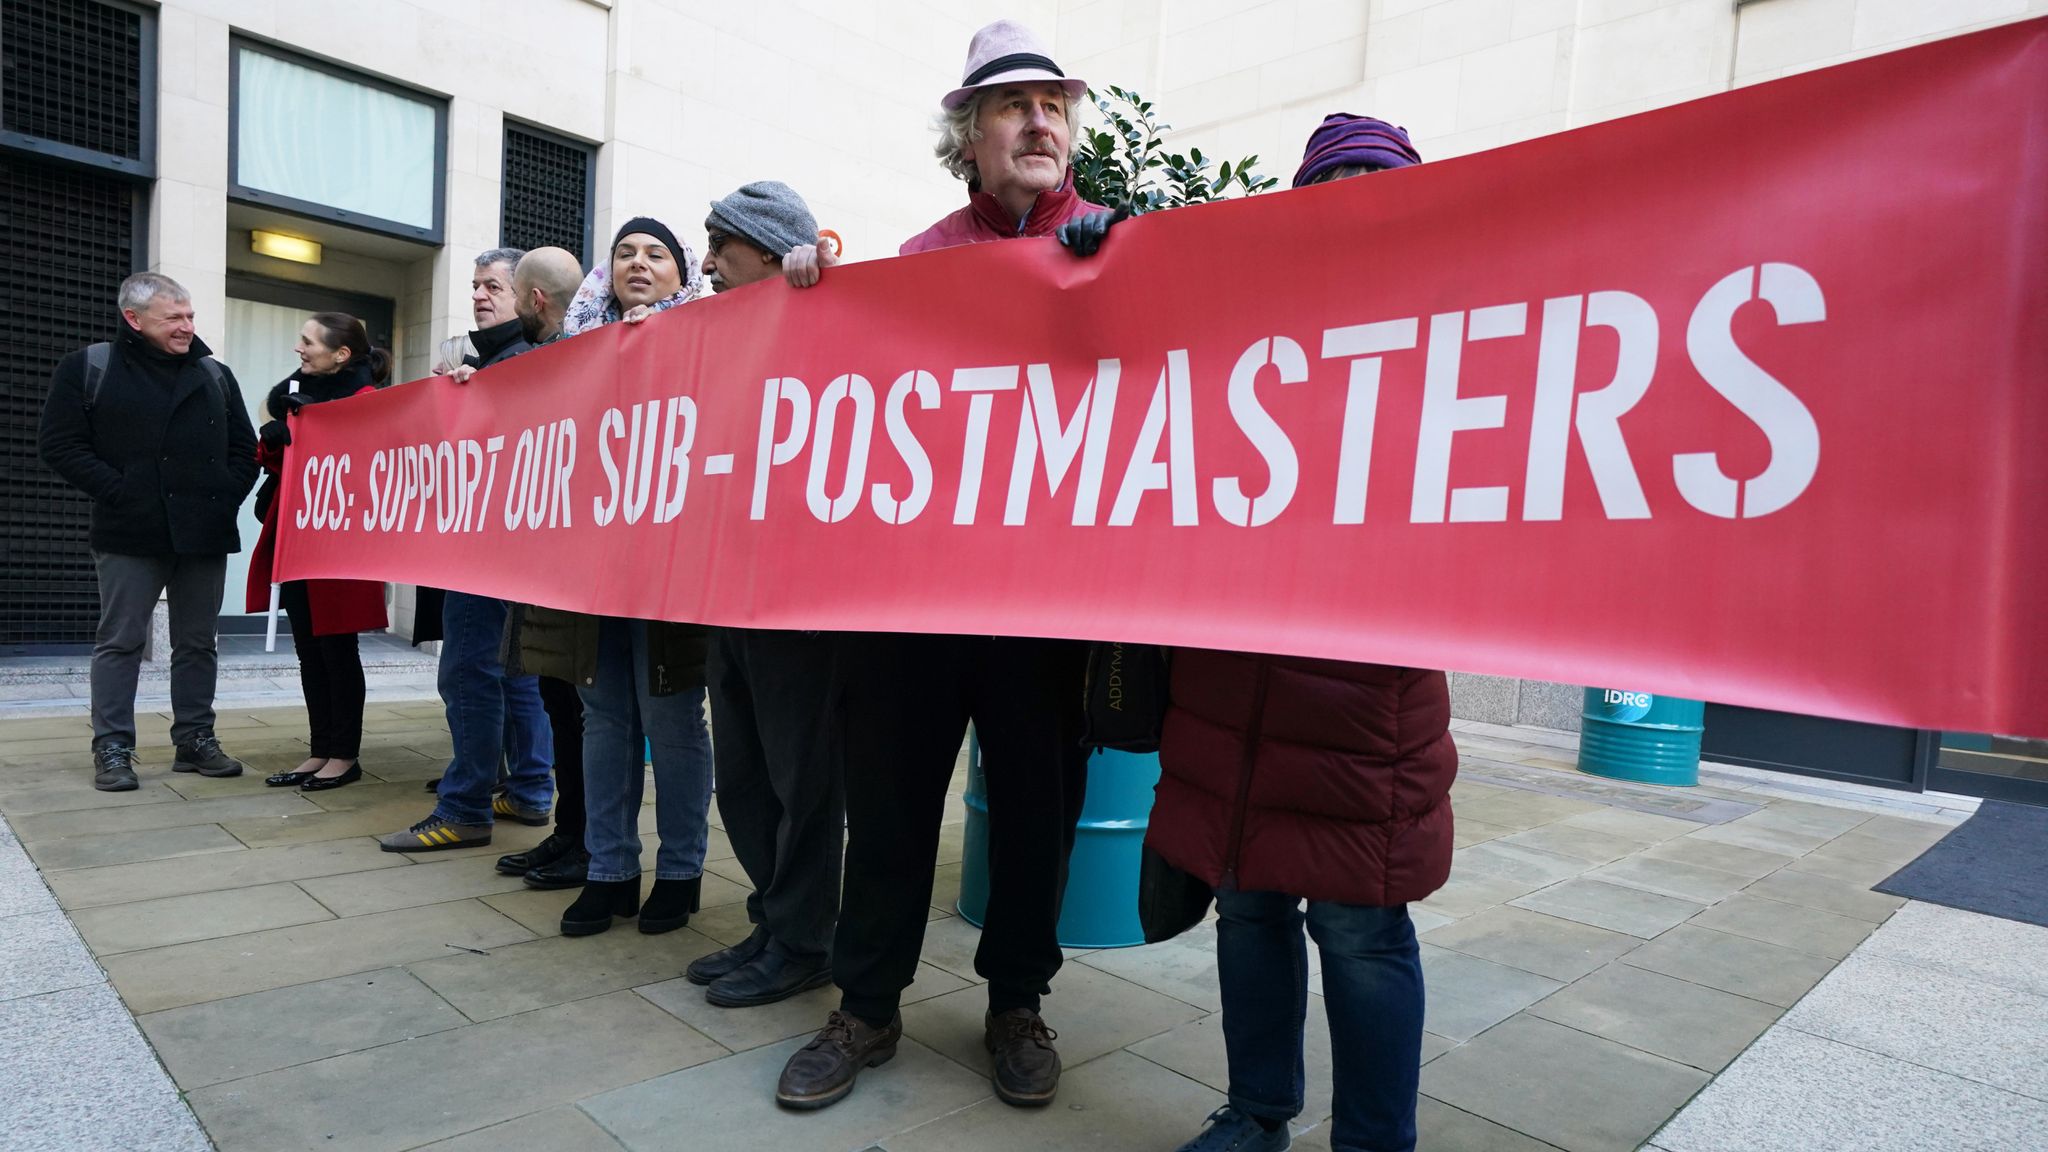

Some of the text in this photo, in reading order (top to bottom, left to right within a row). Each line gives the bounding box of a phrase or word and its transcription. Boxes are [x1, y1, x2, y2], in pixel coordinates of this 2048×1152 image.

[296, 453, 355, 531] SOS:
[363, 435, 505, 534] SUPPORT
[504, 417, 577, 532] OUR
[1604, 689, 1649, 708] IDRC
